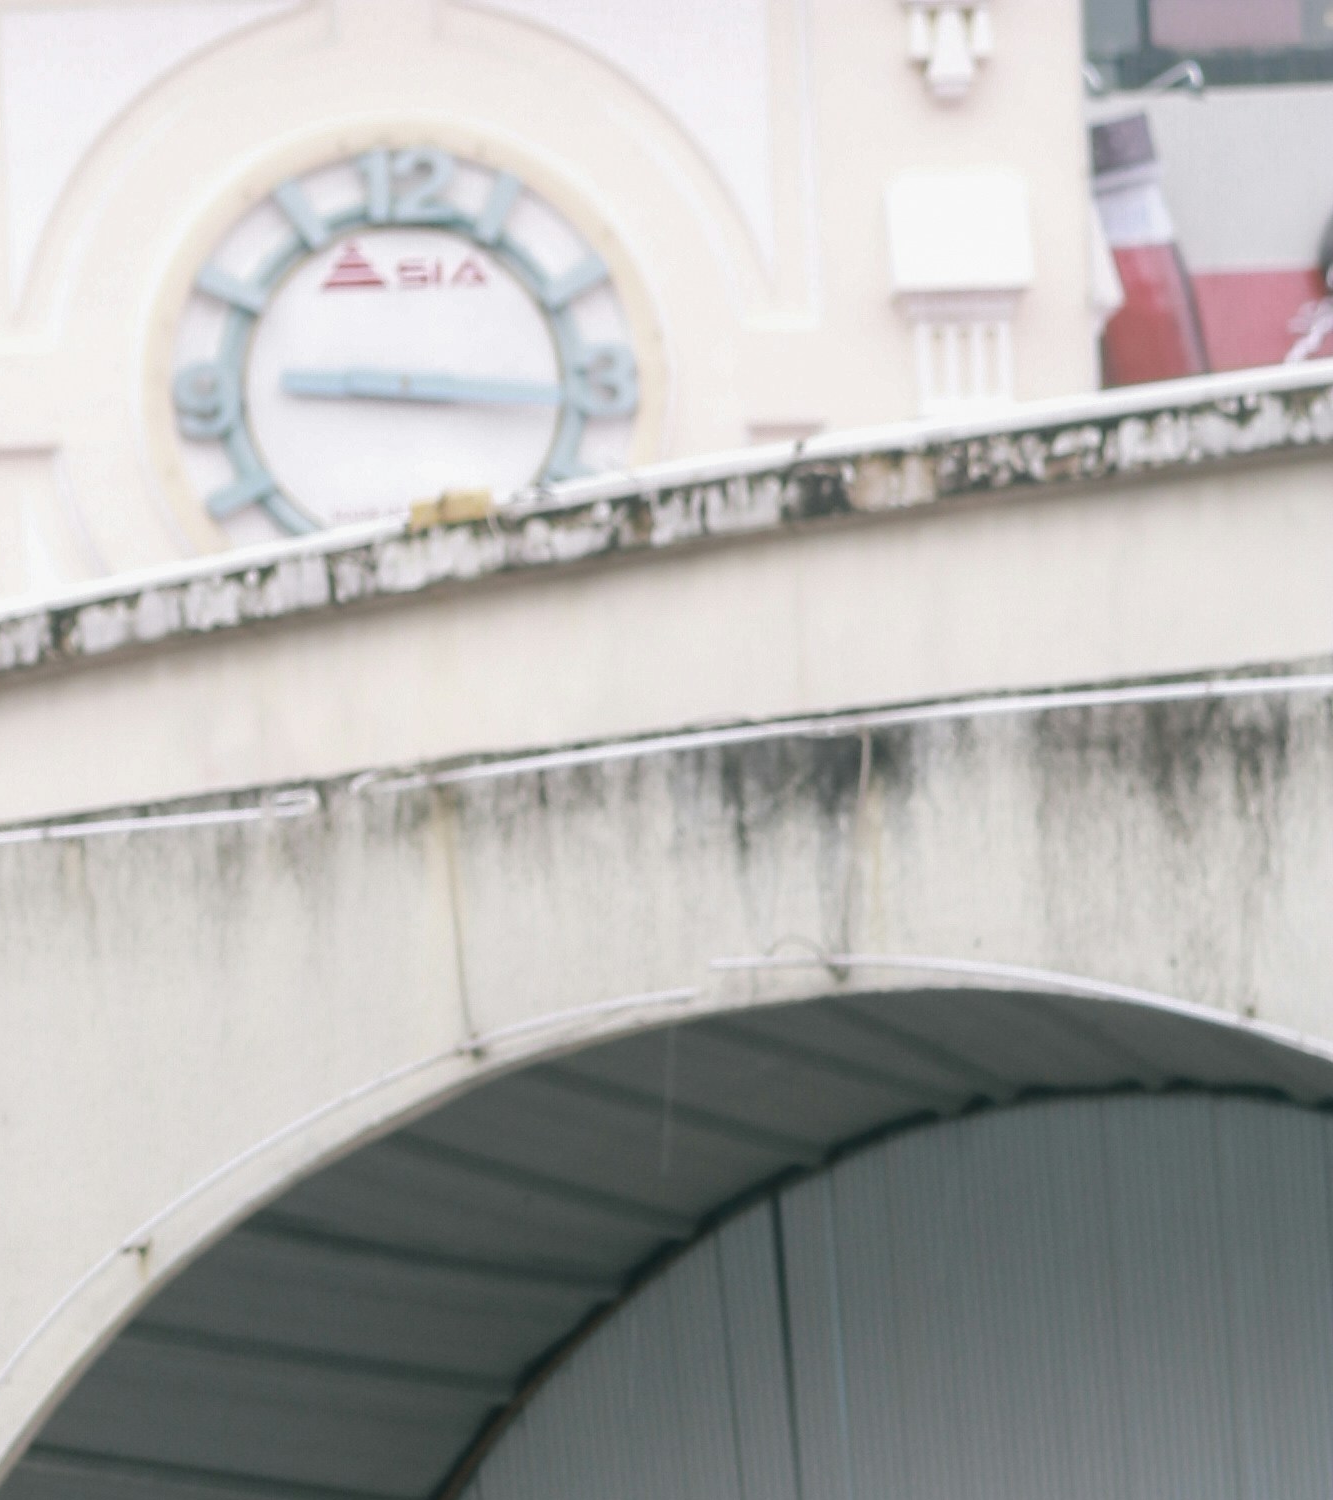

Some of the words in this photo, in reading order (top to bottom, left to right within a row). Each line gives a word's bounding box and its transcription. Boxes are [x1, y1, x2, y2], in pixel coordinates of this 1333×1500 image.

[358, 147, 455, 225] 12
[321, 240, 488, 291] ASIA
[174, 361, 238, 439] 9
[575, 344, 638, 419] 3
